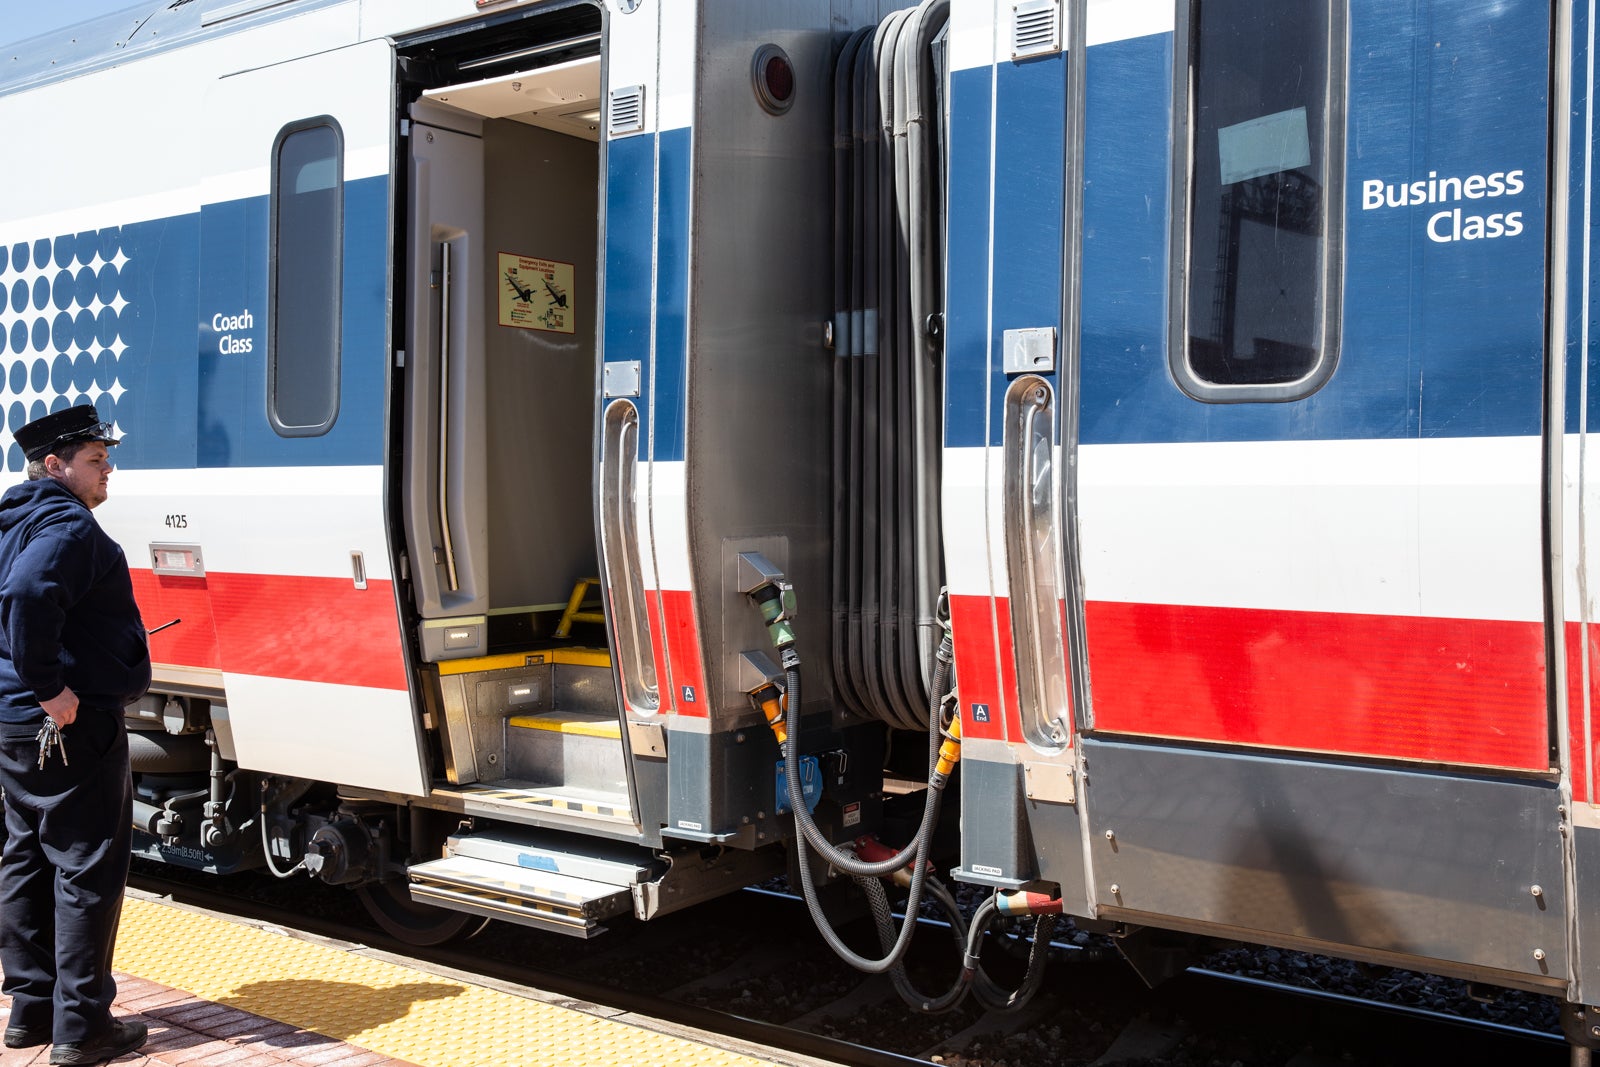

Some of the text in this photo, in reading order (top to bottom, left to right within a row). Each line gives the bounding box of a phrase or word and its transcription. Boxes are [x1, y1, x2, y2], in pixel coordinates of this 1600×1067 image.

[1362, 169, 1525, 210] Business
[1426, 208, 1524, 243] Class
[518, 257, 538, 267] Emergency
[518, 263, 538, 272] Equipment
[212, 308, 254, 332] Coach
[219, 334, 253, 355] Class
[165, 514, 188, 529] 4125
[685, 687, 693, 697] A
[976, 705, 986, 716] A
[974, 865, 991, 873] JACKING
